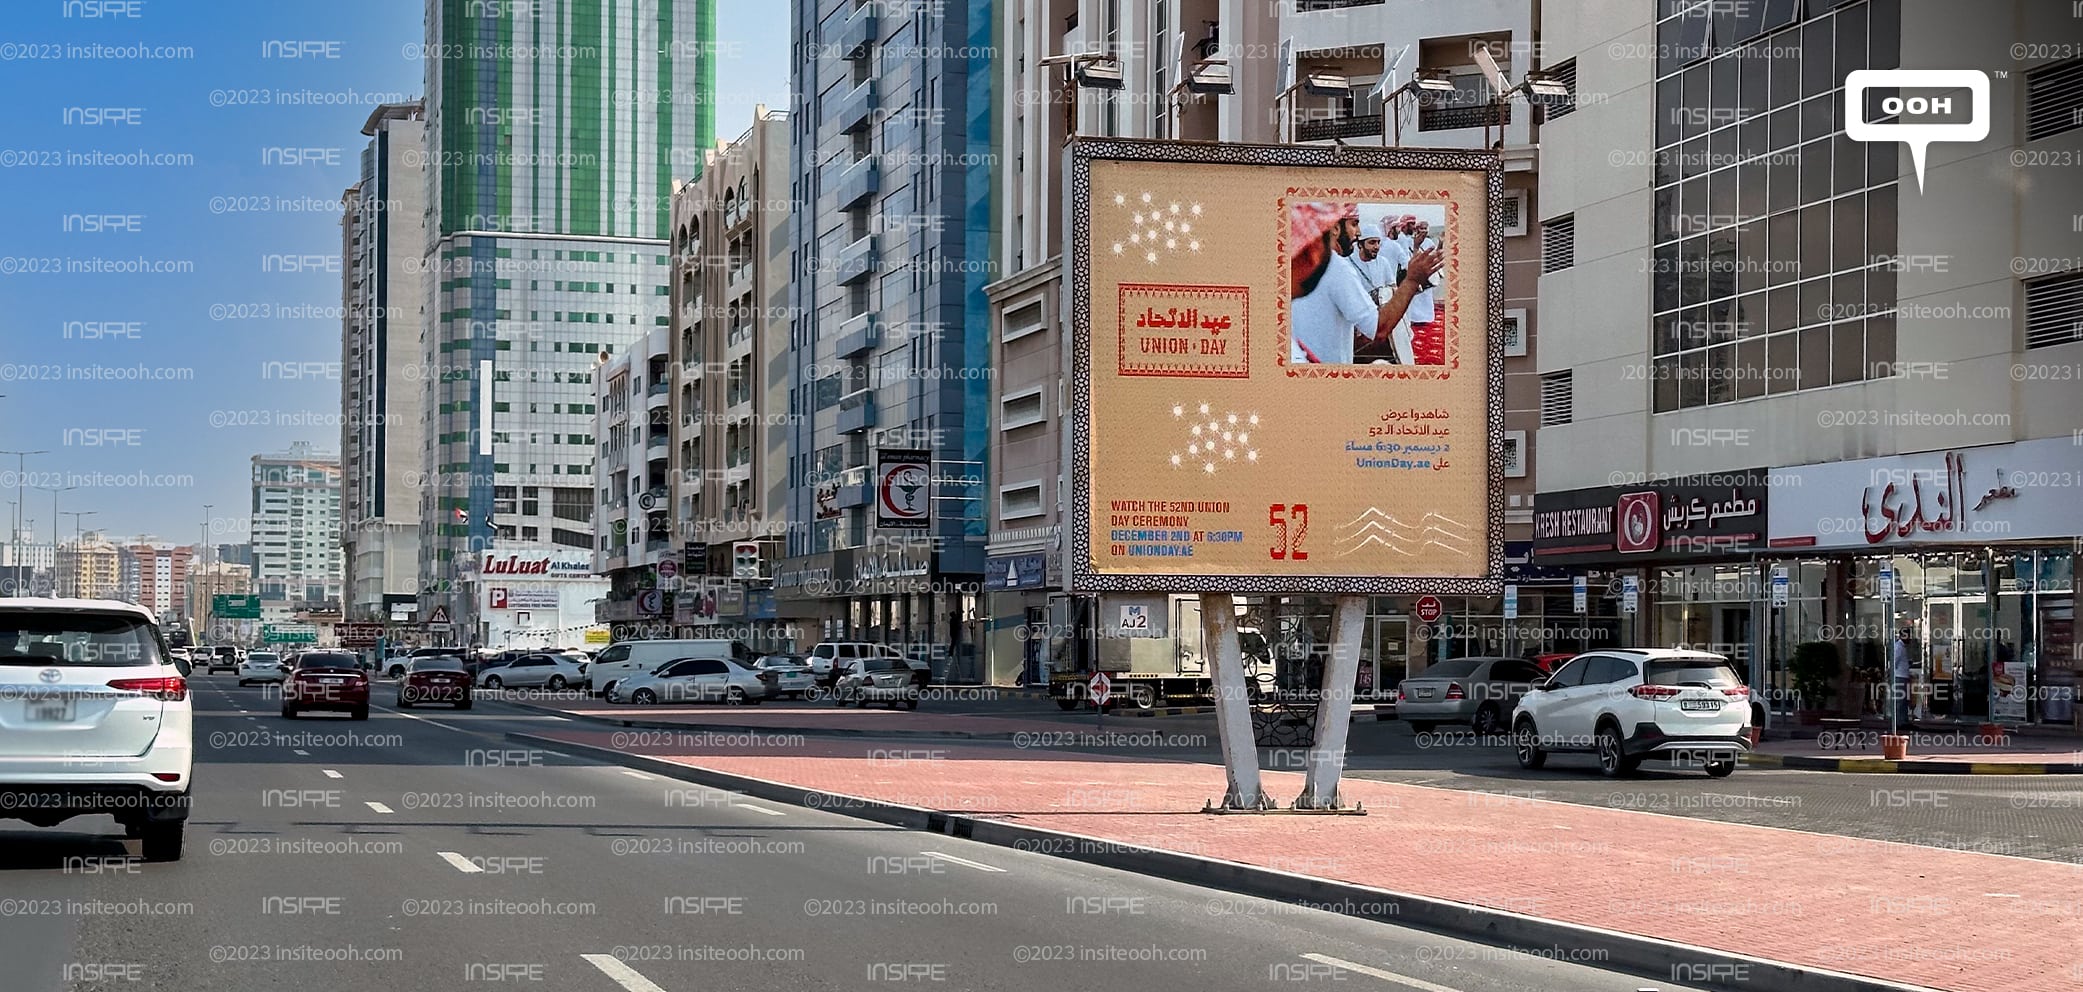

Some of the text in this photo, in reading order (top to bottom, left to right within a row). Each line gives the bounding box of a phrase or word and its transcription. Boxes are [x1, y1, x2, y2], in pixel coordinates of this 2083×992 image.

[1136, 307, 1232, 335] عيد الاتحاد
[1140, 337, 1227, 355] UNION DAY
[1381, 408, 1450, 421] شاهدوا عرض
[1368, 428, 1383, 437] 52
[1395, 424, 1430, 436] الاتحاد
[1432, 428, 1450, 438] عيد
[1375, 440, 1402, 454] 6:30
[1402, 443, 1441, 454] ديسمبر
[1356, 457, 1451, 471] على UnionDay.ae
[1111, 500, 1230, 513] WATCH THE 52ND UNION
[1662, 487, 1756, 531] مطعم كريش
[1111, 515, 1189, 527] DAY CEREMONY
[1535, 505, 1613, 539] KRESH RESTAURANT
[1111, 530, 1243, 542] DECEMBER 2ND AT 6:30PM
[1269, 503, 1309, 561] 52
[1111, 545, 1194, 557] ON UNIONDAY.AE
[482, 554, 551, 575] LuLuat
[551, 562, 561, 570] Al
[491, 589, 505, 607] P
[1420, 608, 1438, 616] STOP
